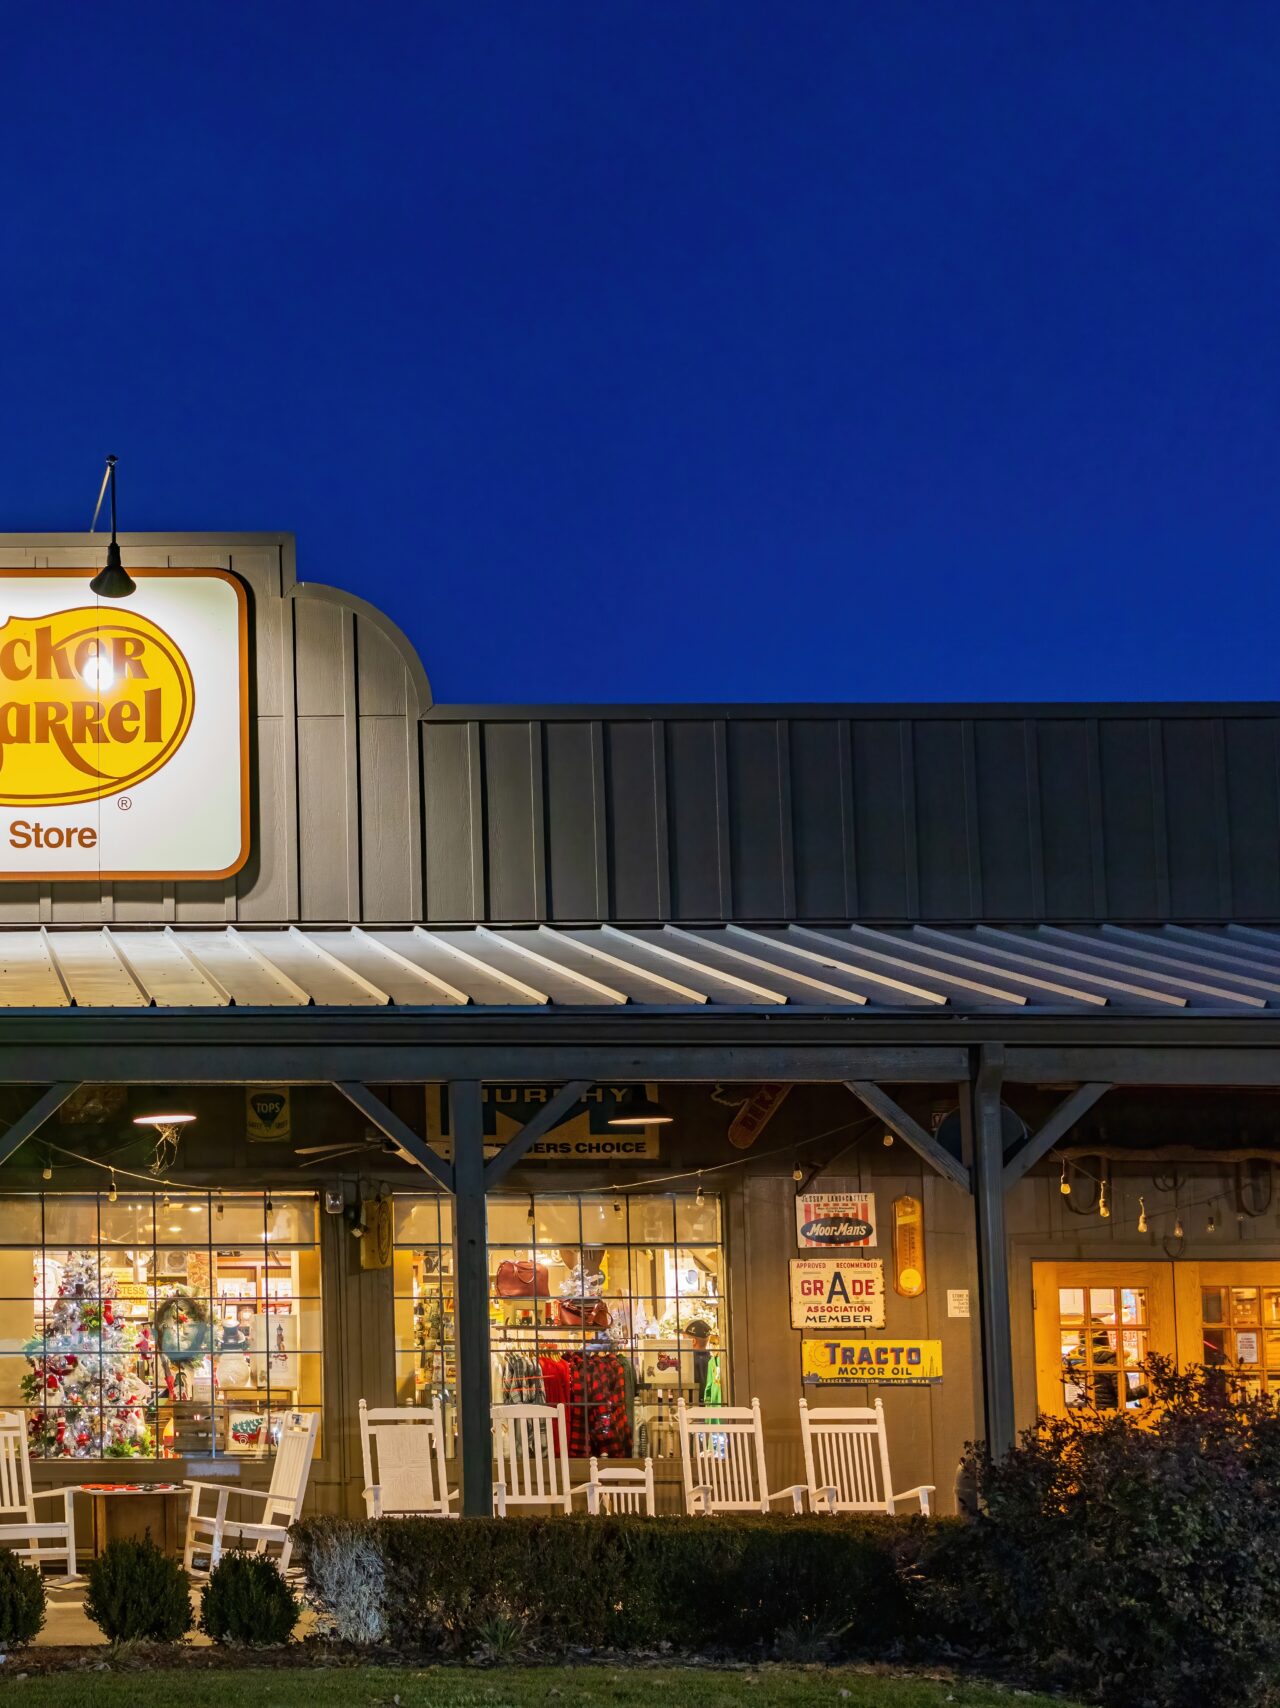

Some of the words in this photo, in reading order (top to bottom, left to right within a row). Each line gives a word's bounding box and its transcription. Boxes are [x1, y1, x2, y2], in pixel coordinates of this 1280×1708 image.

[9, 820, 97, 849] Store
[256, 1102, 280, 1113] TOPS
[577, 1142, 647, 1153] CHOICE
[806, 1305, 871, 1313] ASSOCIATION
[805, 1314, 873, 1323] MEMBER
[824, 1342, 921, 1366] TRACTO
[838, 1367, 885, 1376] MOTOR
[891, 1367, 912, 1376] OIL
